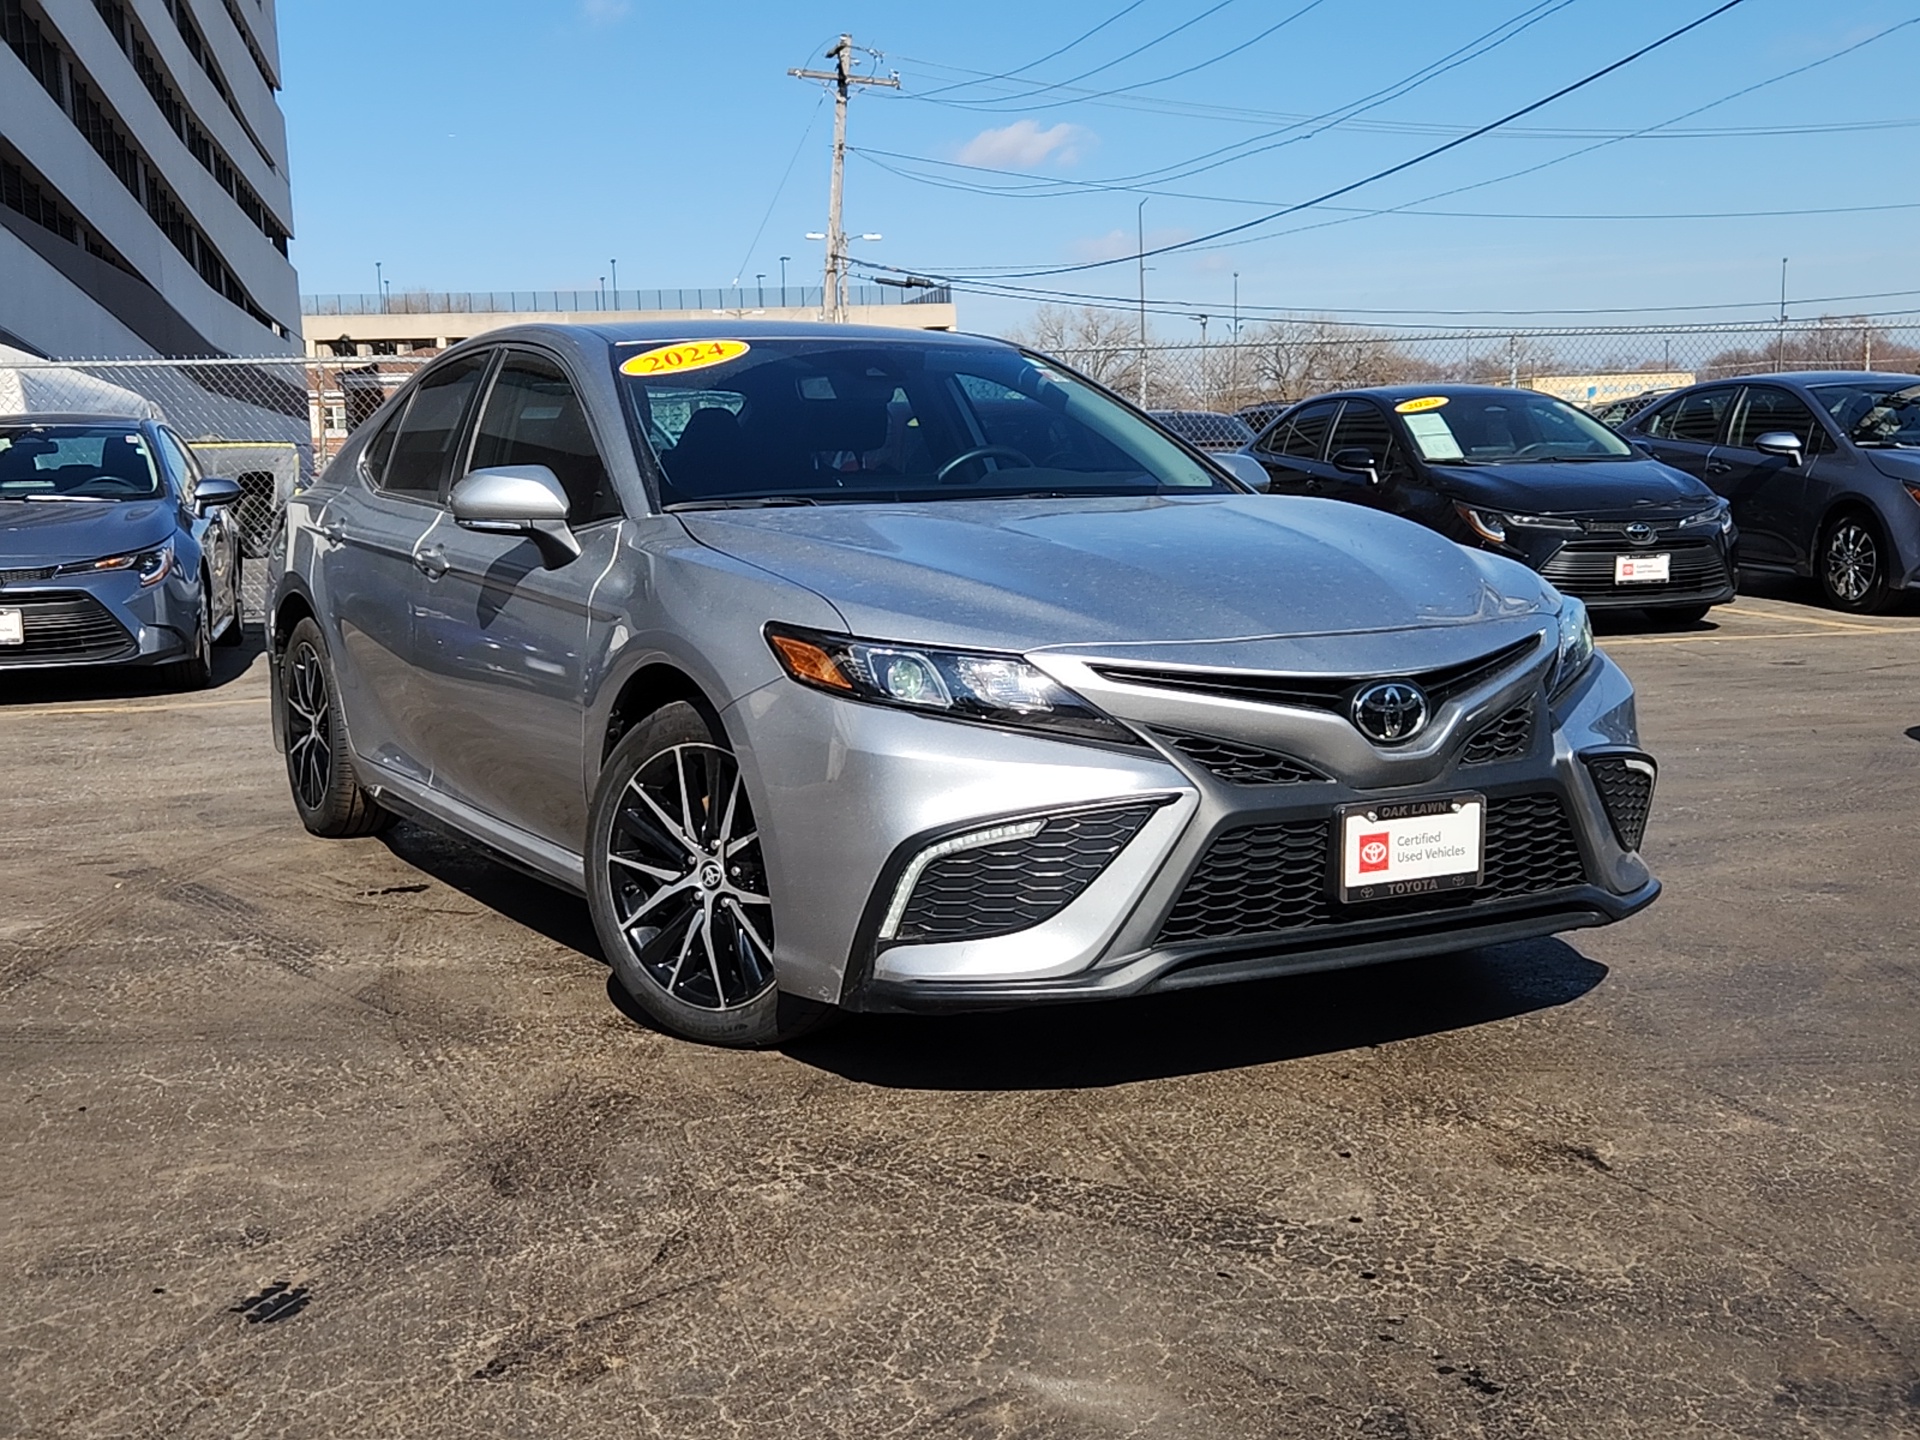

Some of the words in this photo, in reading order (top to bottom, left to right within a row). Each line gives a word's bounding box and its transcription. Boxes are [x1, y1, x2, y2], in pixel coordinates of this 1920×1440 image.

[643, 342, 725, 372] 2024
[1382, 806, 1408, 818] OAK
[1412, 802, 1447, 815] LAWN
[1397, 831, 1441, 846] Certified
[1397, 849, 1423, 863] Used
[1425, 844, 1466, 860] Vehicles
[1387, 879, 1438, 895] TOYOTA
